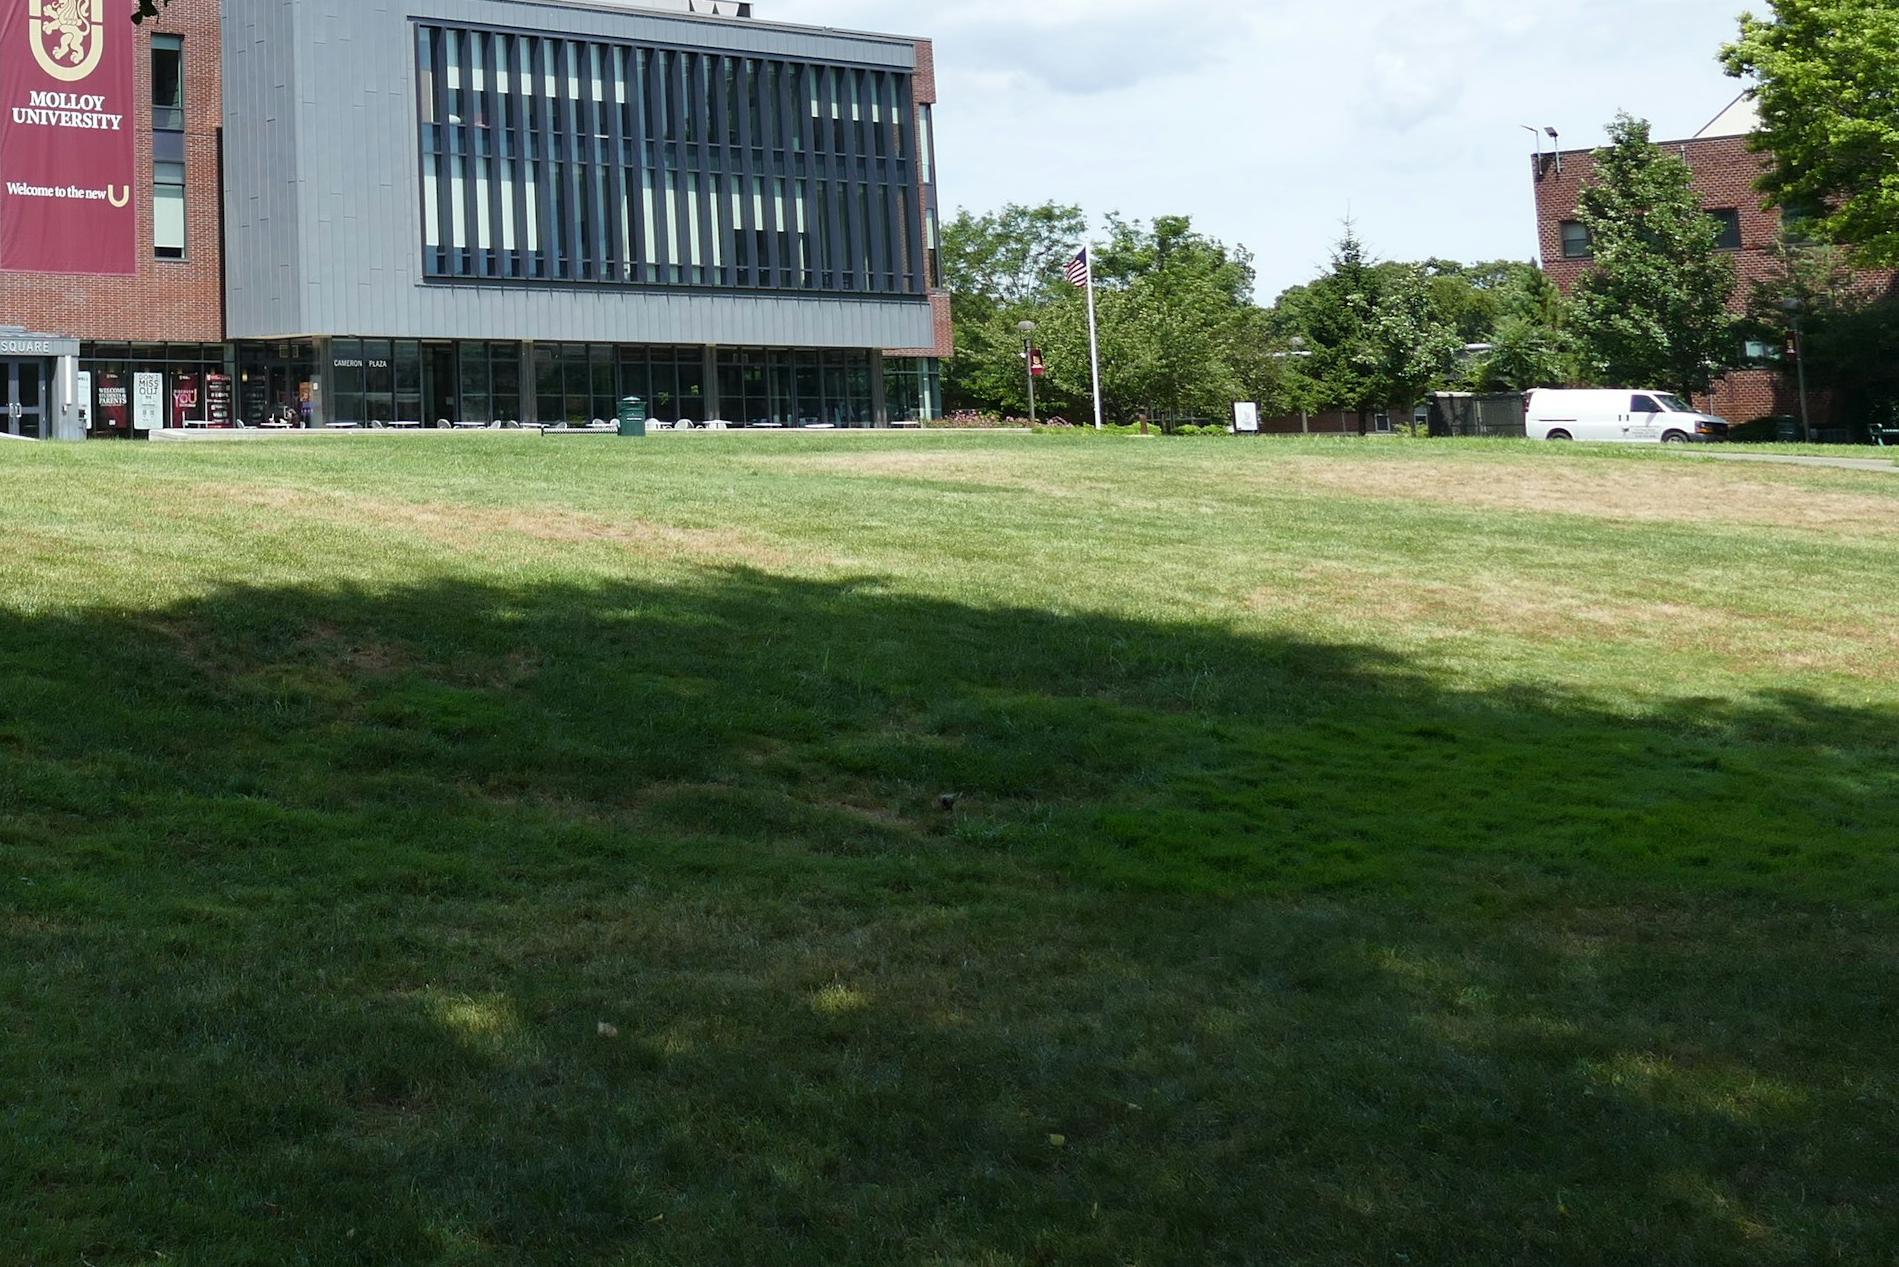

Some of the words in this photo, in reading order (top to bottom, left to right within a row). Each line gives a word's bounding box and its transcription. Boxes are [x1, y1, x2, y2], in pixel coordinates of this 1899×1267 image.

[29, 90, 105, 111] MOLLOY
[12, 107, 122, 130] UNIVERSITY
[6, 181, 55, 197] Welcome
[55, 186, 66, 198] to
[66, 185, 84, 199] the
[85, 190, 106, 200] new
[107, 184, 129, 208] U
[0, 340, 50, 353] SQUARE
[333, 359, 363, 367] CAMERON
[368, 360, 388, 368] PLAZA
[139, 379, 159, 387] MISS
[139, 387, 158, 395] OUT
[98, 397, 127, 405] PARENTS
[173, 388, 197, 408] YOU
